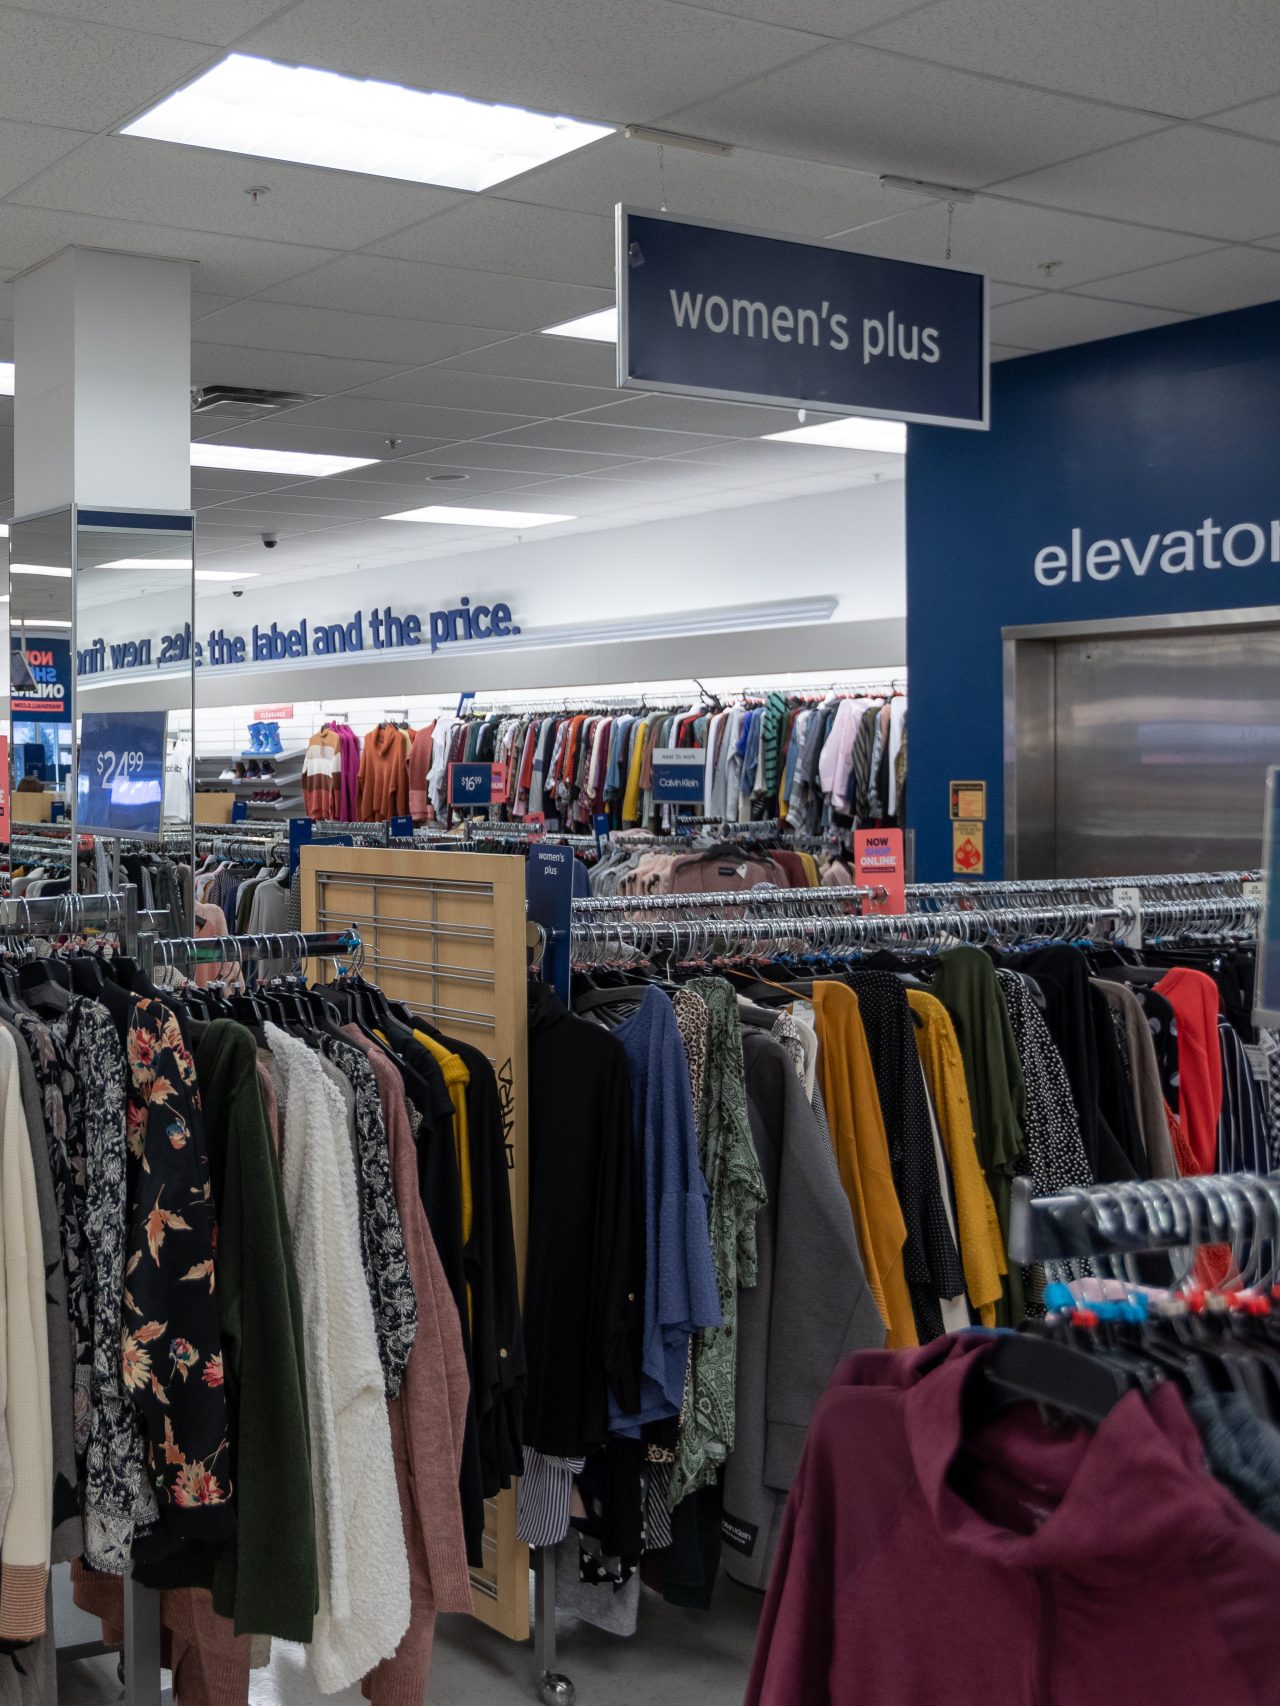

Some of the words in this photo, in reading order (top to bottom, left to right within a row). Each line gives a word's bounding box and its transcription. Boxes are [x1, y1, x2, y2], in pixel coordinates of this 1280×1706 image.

[669, 287, 849, 352] women's
[862, 309, 941, 365] plus
[208, 628, 245, 665] the
[252, 618, 308, 661] label
[313, 610, 364, 655] and
[369, 606, 421, 649] the
[430, 597, 522, 654] price.
[659, 778, 681, 787] Calvin
[681, 778, 699, 787] Klein
[866, 838, 889, 847] NOW
[538, 852, 565, 863] women's
[860, 856, 897, 866] ONLINE
[544, 866, 558, 876] plus
